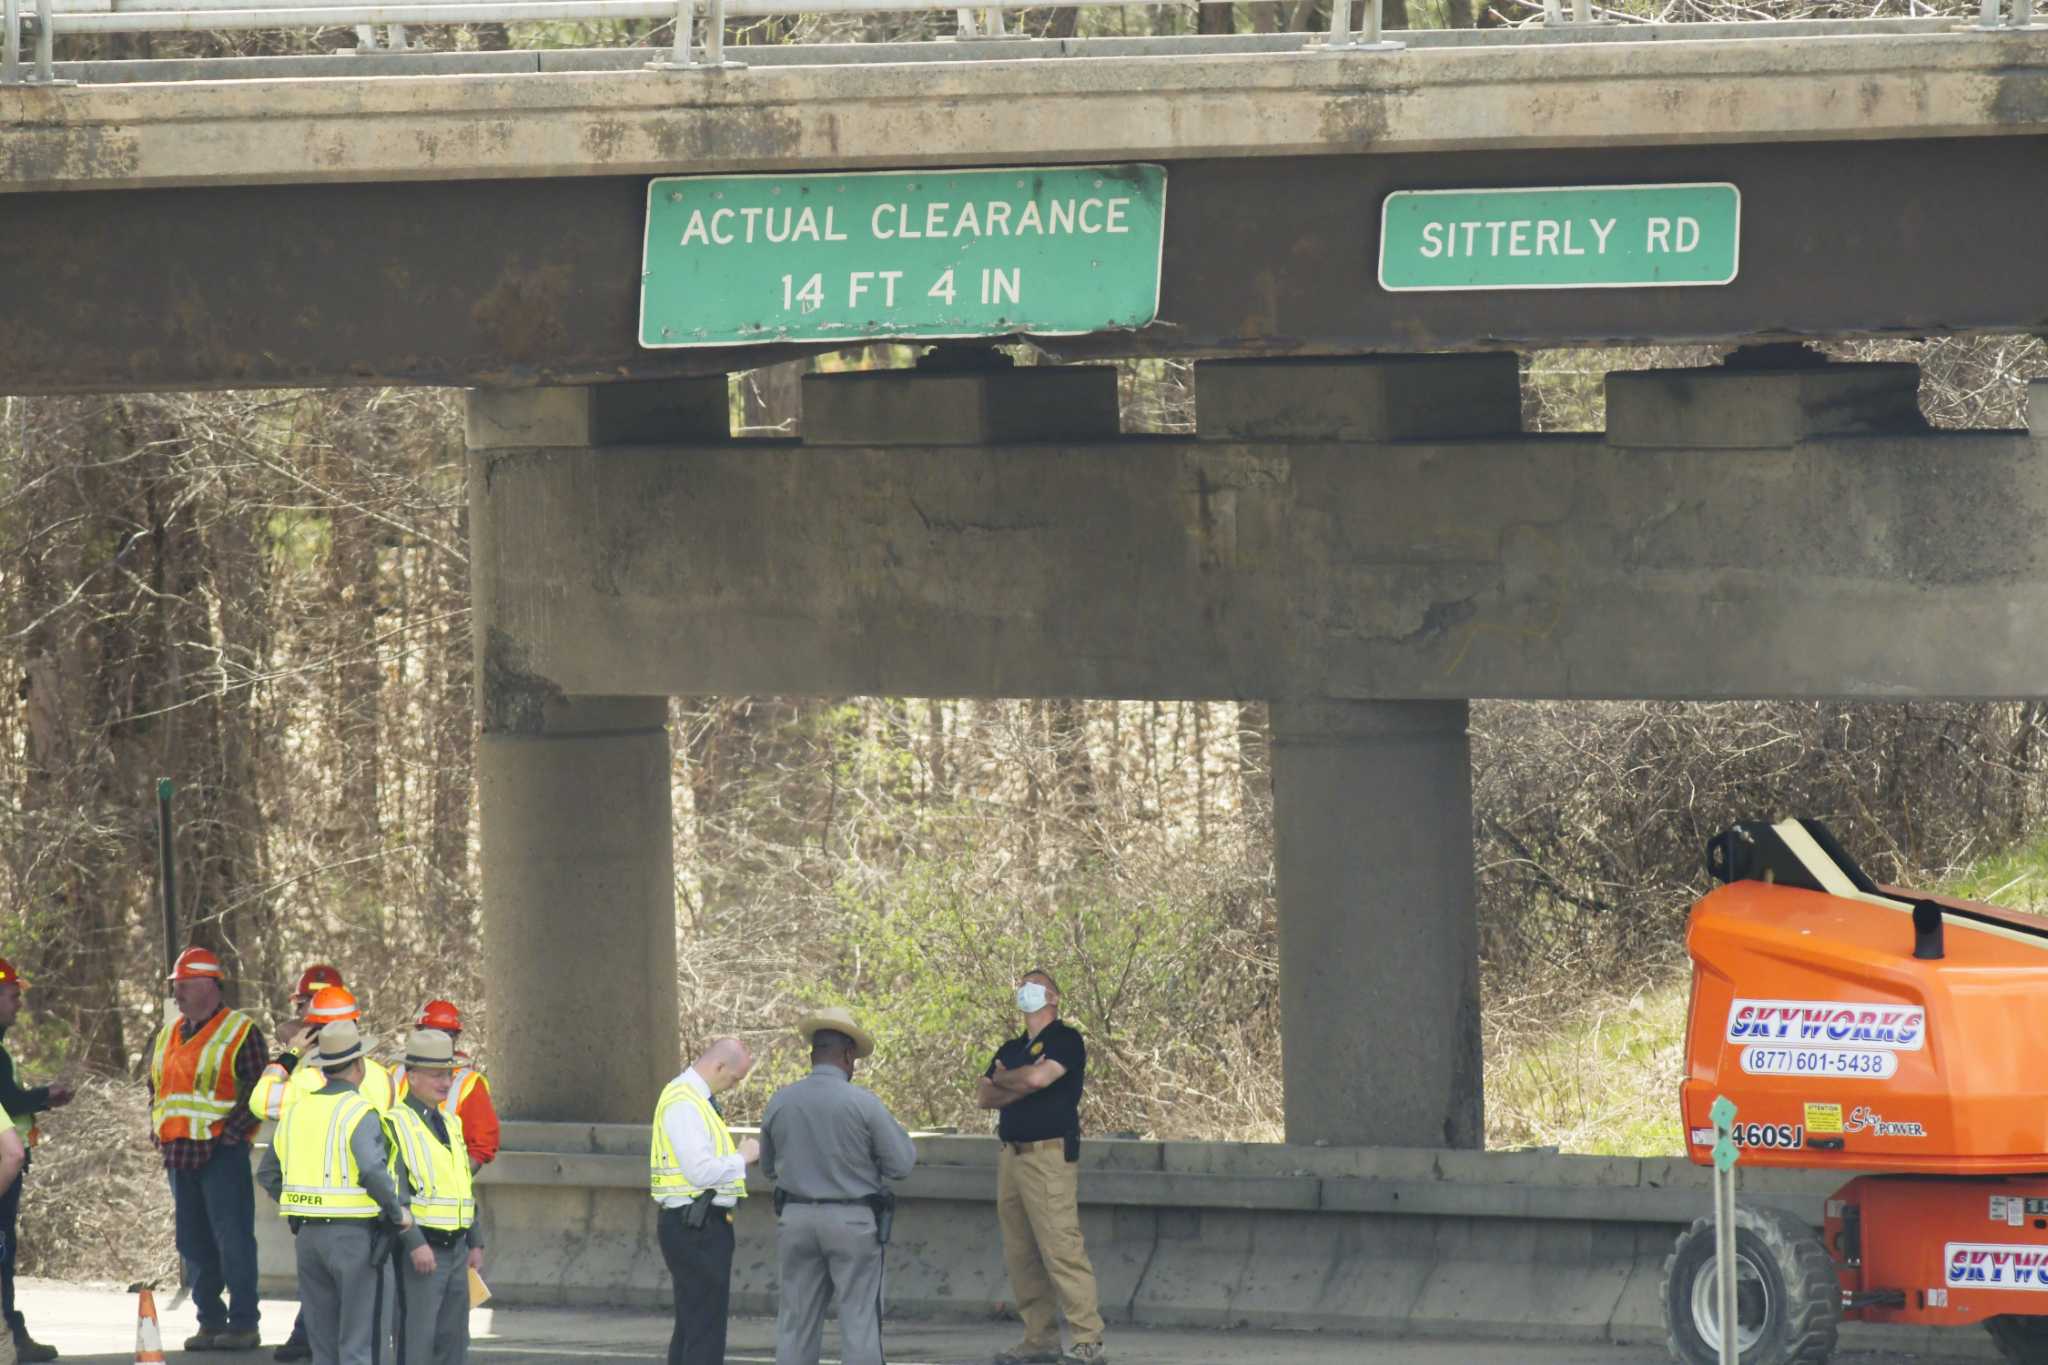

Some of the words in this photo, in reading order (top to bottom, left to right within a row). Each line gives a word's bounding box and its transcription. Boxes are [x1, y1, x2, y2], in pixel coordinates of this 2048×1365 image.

[680, 206, 848, 246] ACTUAL
[871, 198, 1130, 240] CLEARANCE
[1419, 218, 1617, 258] SITTERLY
[1647, 217, 1701, 253] RD
[782, 273, 824, 310] 14
[848, 271, 904, 308] FT
[928, 269, 957, 305] 4
[981, 268, 1021, 305] IN
[1730, 1006, 1923, 1044] SKYWORKS
[1731, 1123, 1803, 1149] 460SJ
